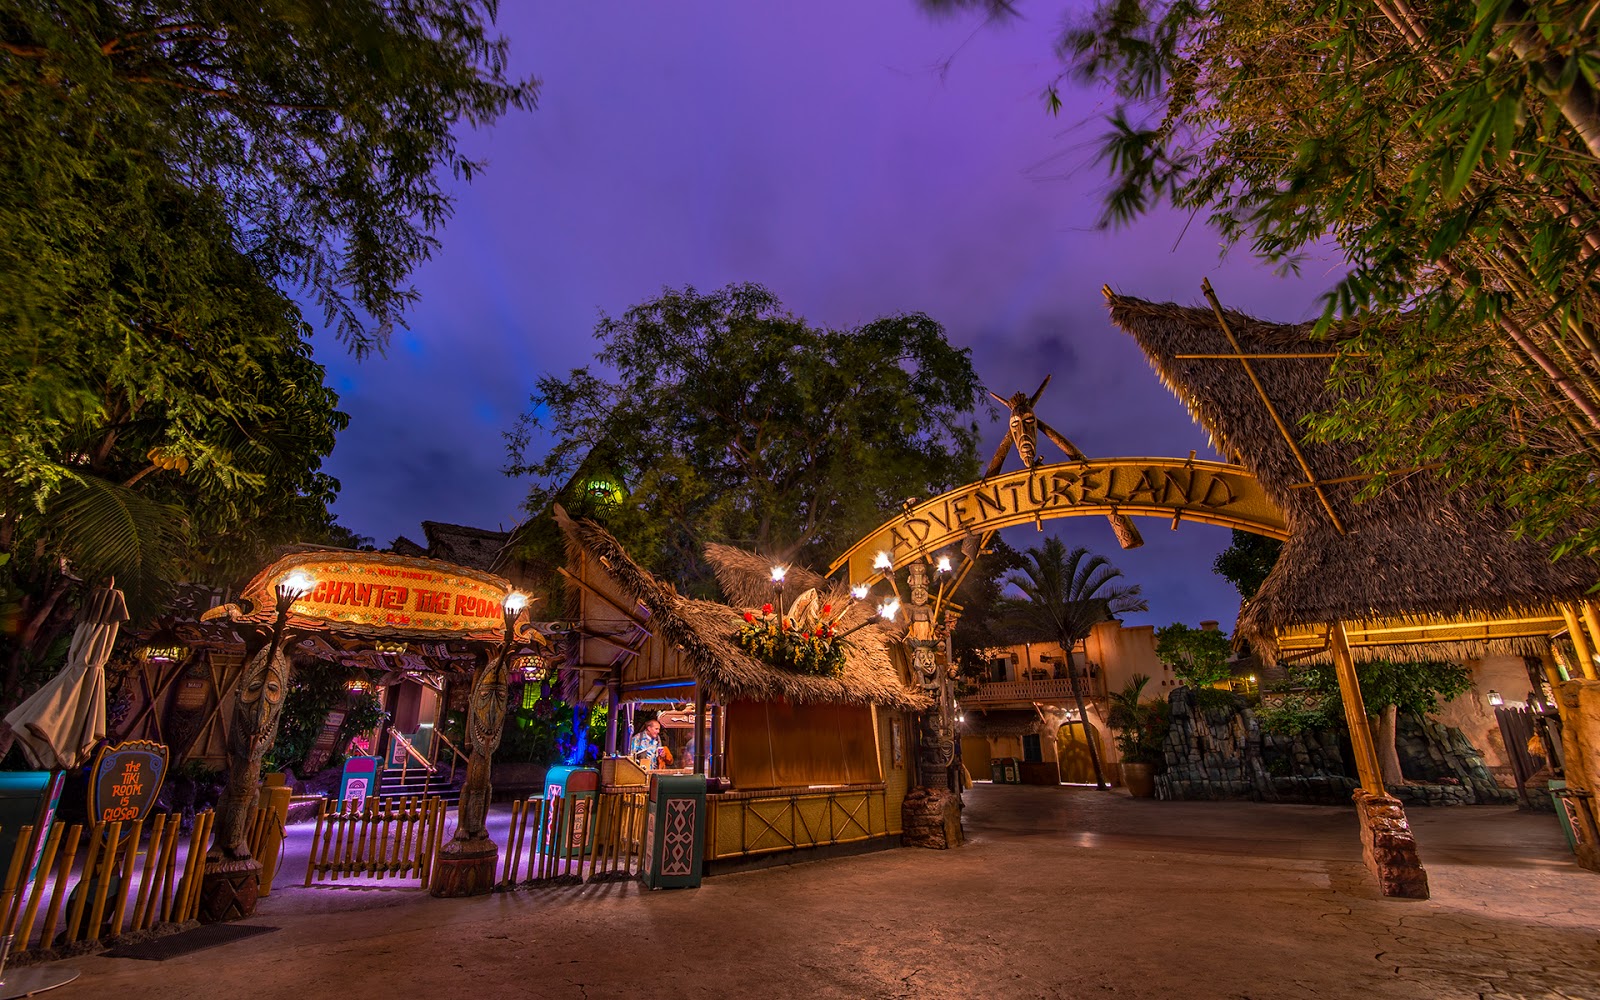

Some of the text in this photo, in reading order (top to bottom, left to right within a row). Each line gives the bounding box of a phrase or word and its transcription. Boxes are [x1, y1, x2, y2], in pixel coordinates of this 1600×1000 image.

[889, 467, 1236, 552] ADVENTURELAND
[378, 568, 400, 577] WALT
[296, 580, 408, 610] CHANTED
[454, 595, 502, 619] ROOM
[112, 783, 143, 797] ROOM
